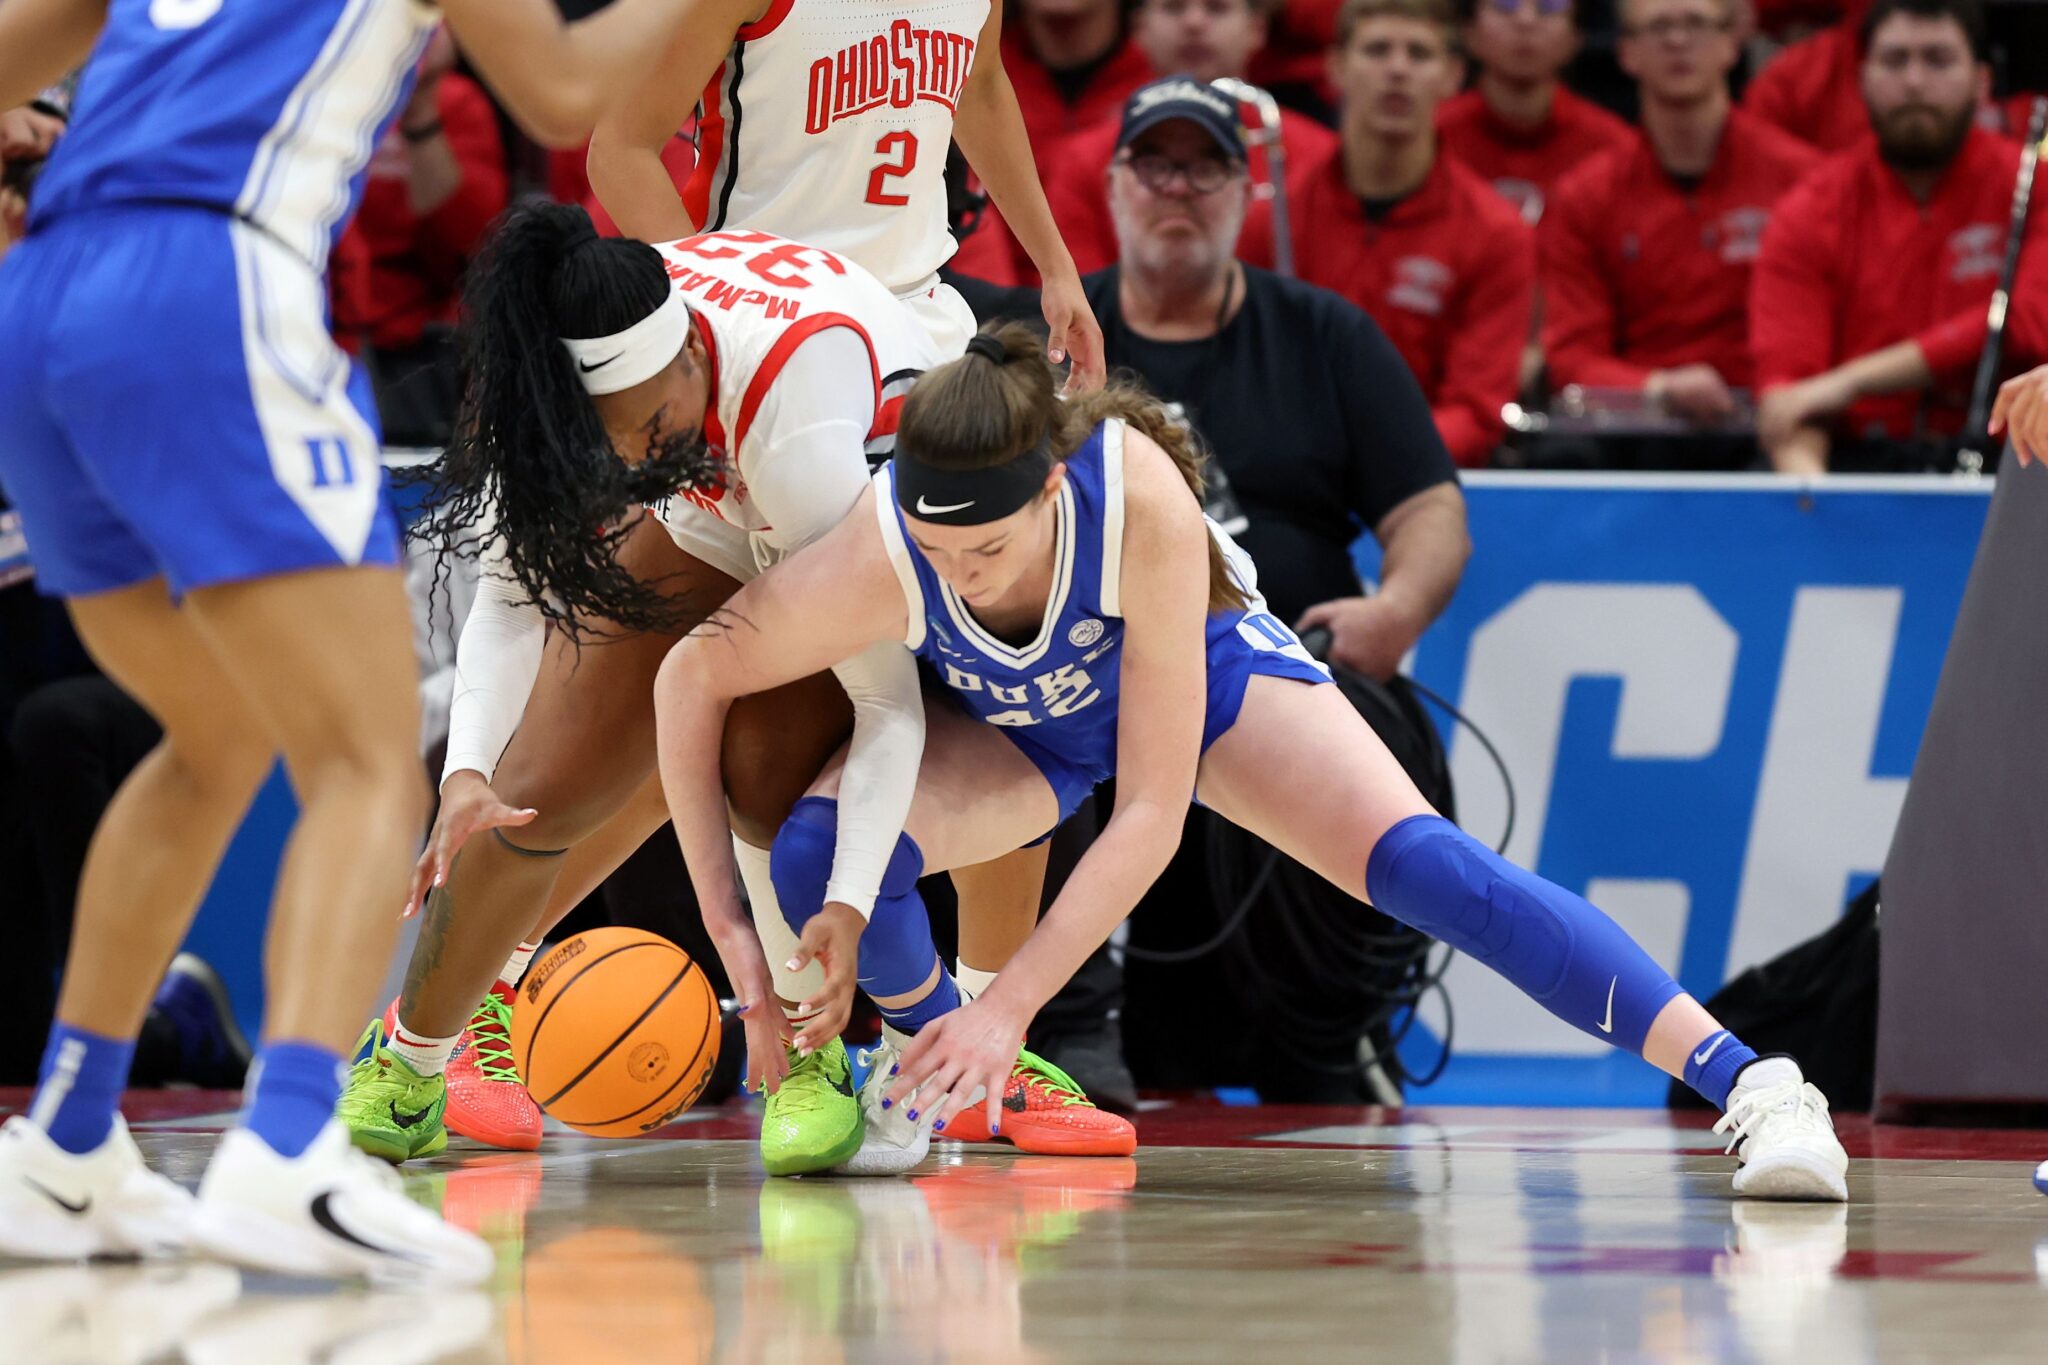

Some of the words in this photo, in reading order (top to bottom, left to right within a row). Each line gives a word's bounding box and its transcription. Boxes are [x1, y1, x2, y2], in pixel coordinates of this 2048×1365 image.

[805, 34, 889, 135] OHIO
[864, 130, 919, 206] 2
[664, 258, 801, 321] McMAH
